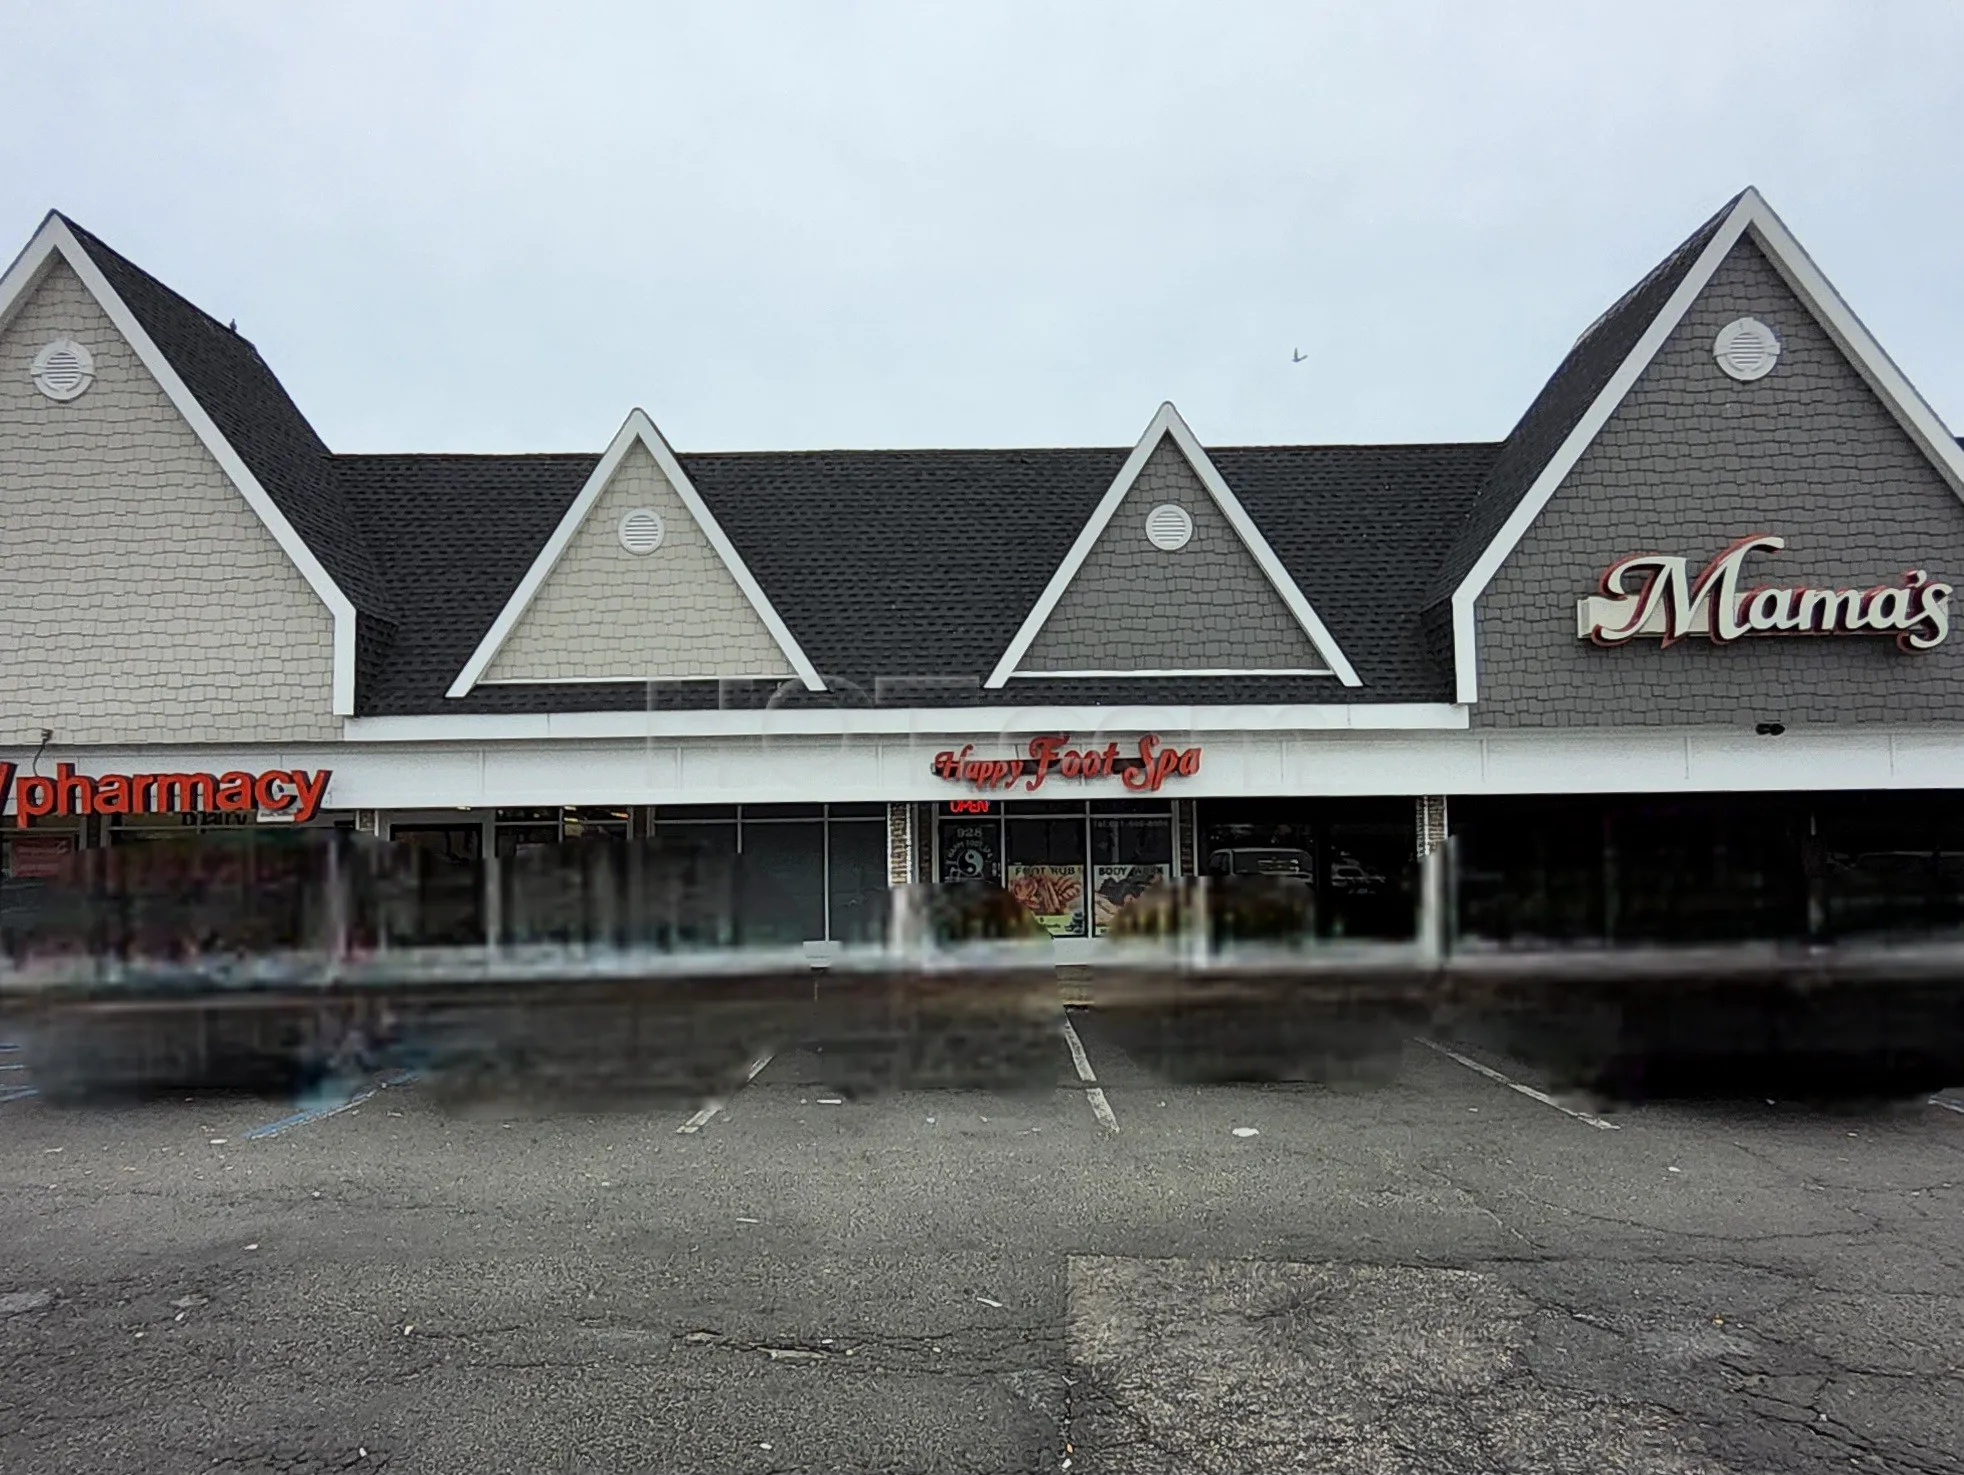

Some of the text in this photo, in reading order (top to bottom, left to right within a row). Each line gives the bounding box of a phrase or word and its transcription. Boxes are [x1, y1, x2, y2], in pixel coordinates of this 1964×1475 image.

[1592, 533, 1953, 653] Mama's
[935, 734, 1201, 791] Happy Foot Spa
[950, 800, 989, 813] OPEN
[1050, 866, 1075, 875] RUB
[1099, 866, 1127, 875] BODY
